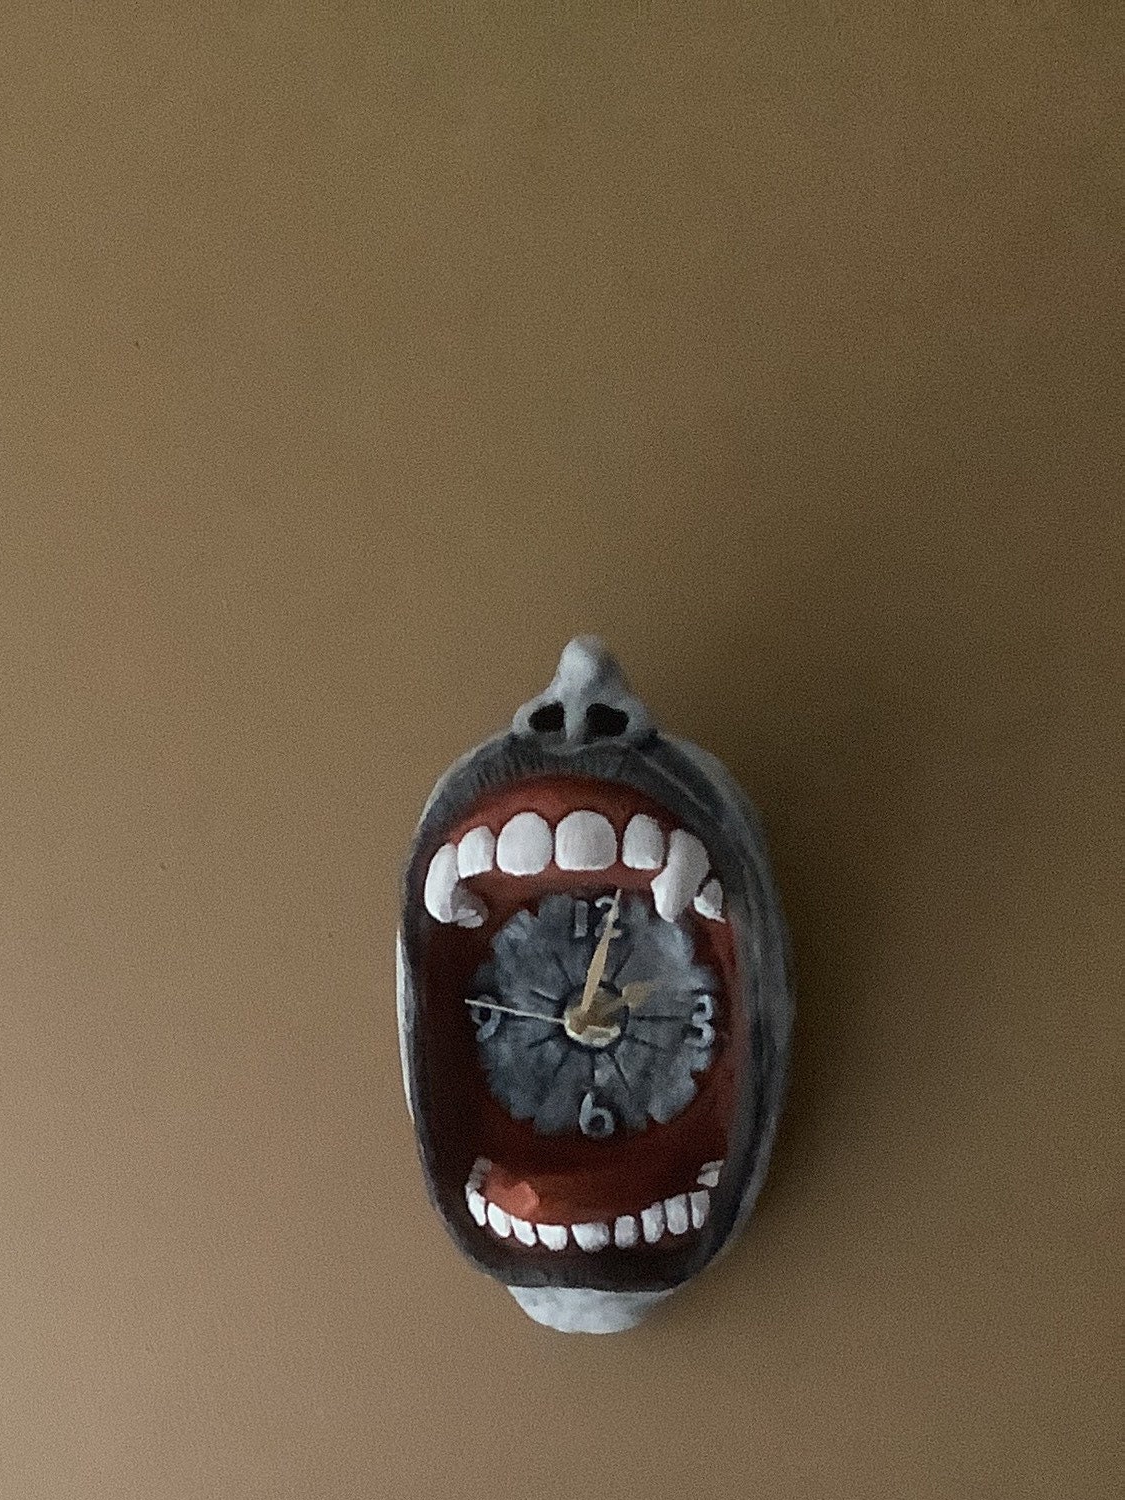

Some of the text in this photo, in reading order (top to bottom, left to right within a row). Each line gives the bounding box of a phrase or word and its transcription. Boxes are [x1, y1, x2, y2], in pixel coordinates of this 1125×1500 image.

[469, 994, 502, 1042] 9
[686, 994, 715, 1047] 3
[579, 1092, 614, 1136] 6
